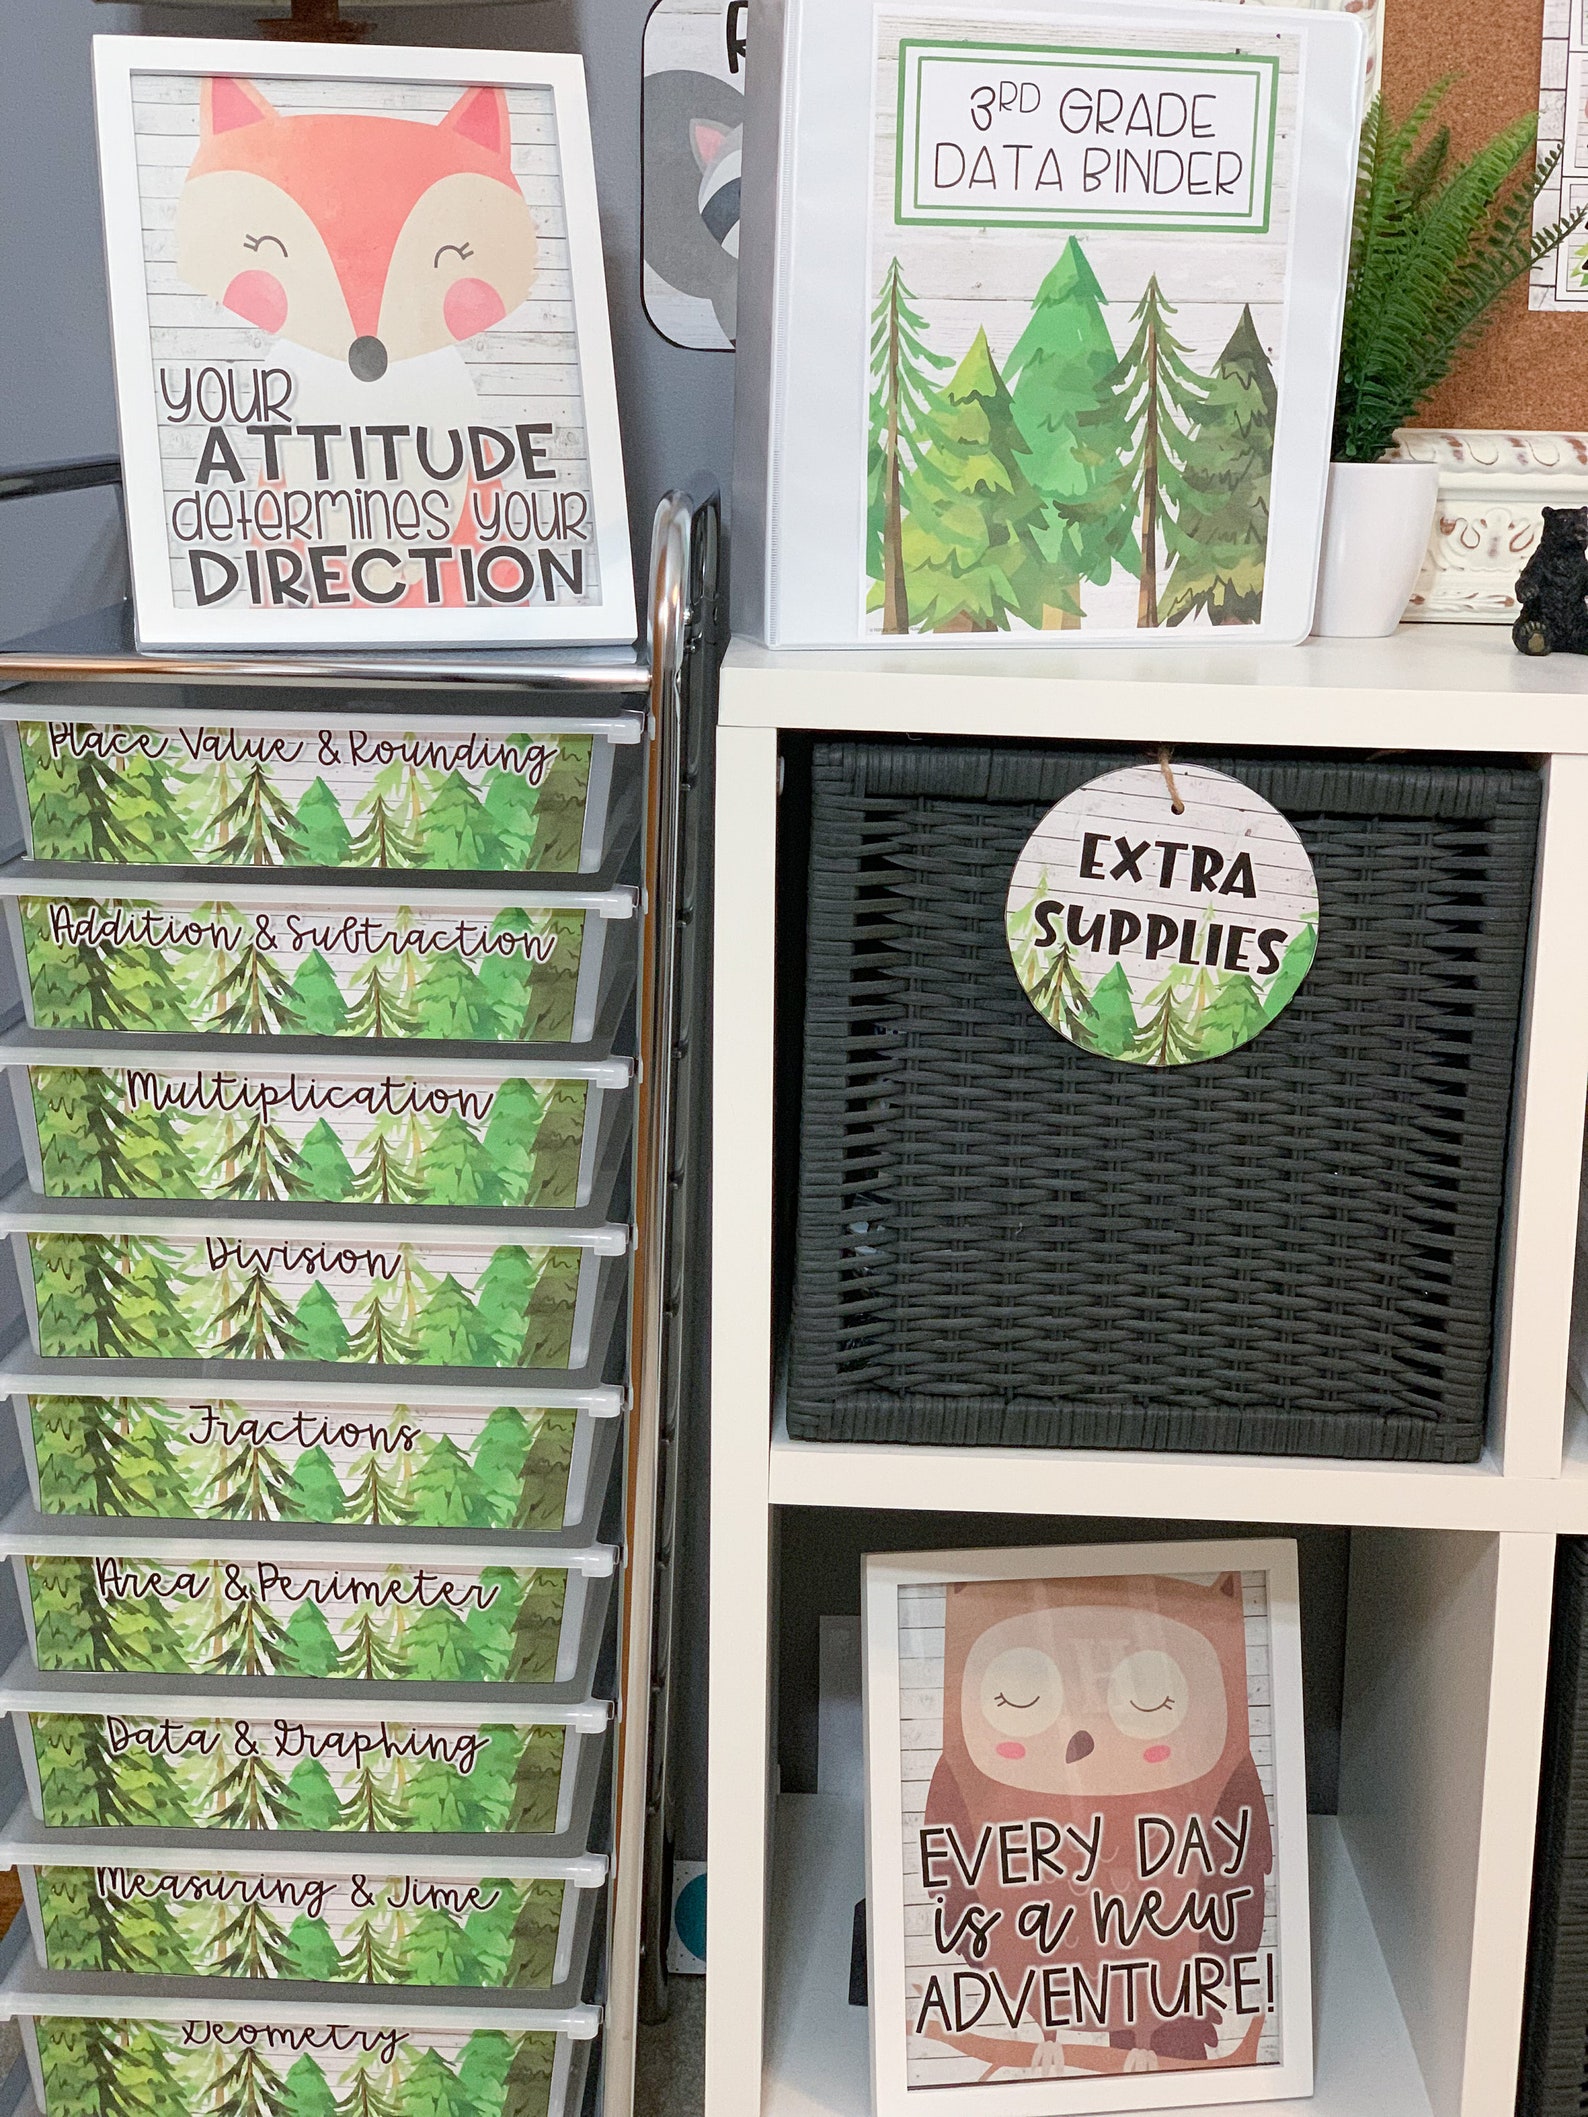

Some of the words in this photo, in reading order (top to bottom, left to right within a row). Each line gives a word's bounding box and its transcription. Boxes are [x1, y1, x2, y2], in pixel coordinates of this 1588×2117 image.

[969, 80, 1041, 133] 3RD
[1059, 87, 1217, 138] GRADE
[934, 142, 1063, 191] DATA
[1084, 146, 1243, 196] BINDER
[195, 423, 557, 484] ATTITUDE
[172, 487, 449, 541] determines
[187, 544, 583, 606] DIRECTION
[50, 722, 168, 758] Place
[179, 726, 304, 763] Value
[318, 730, 341, 765] &
[350, 730, 558, 786] Rounding
[1079, 832, 1257, 898] EXTRA
[50, 904, 243, 952] Addition
[255, 914, 279, 951] &
[292, 916, 557, 962] Subtraction
[1034, 900, 1288, 975] SUPPLIES
[126, 1069, 495, 1124] Multiplication
[206, 1236, 401, 1280] Division
[188, 1405, 421, 1452] Fractions
[96, 1557, 210, 1598] Area
[224, 1563, 249, 1600] &
[257, 1561, 500, 1609] Perimeter
[107, 1715, 221, 1754] Data
[234, 1720, 259, 1757] &
[274, 1719, 490, 1774] Graphing
[919, 1816, 1101, 1888] EVERY
[1138, 1809, 1249, 1877] DAY
[97, 1866, 337, 1918] Measuring
[351, 1874, 375, 1907] &
[934, 1896, 1002, 1958] is
[1018, 1901, 1074, 1954] a
[1094, 1889, 1251, 1946] new
[916, 1952, 1274, 2033] ADVENTURE!
[182, 2020, 410, 2064] Geometry
